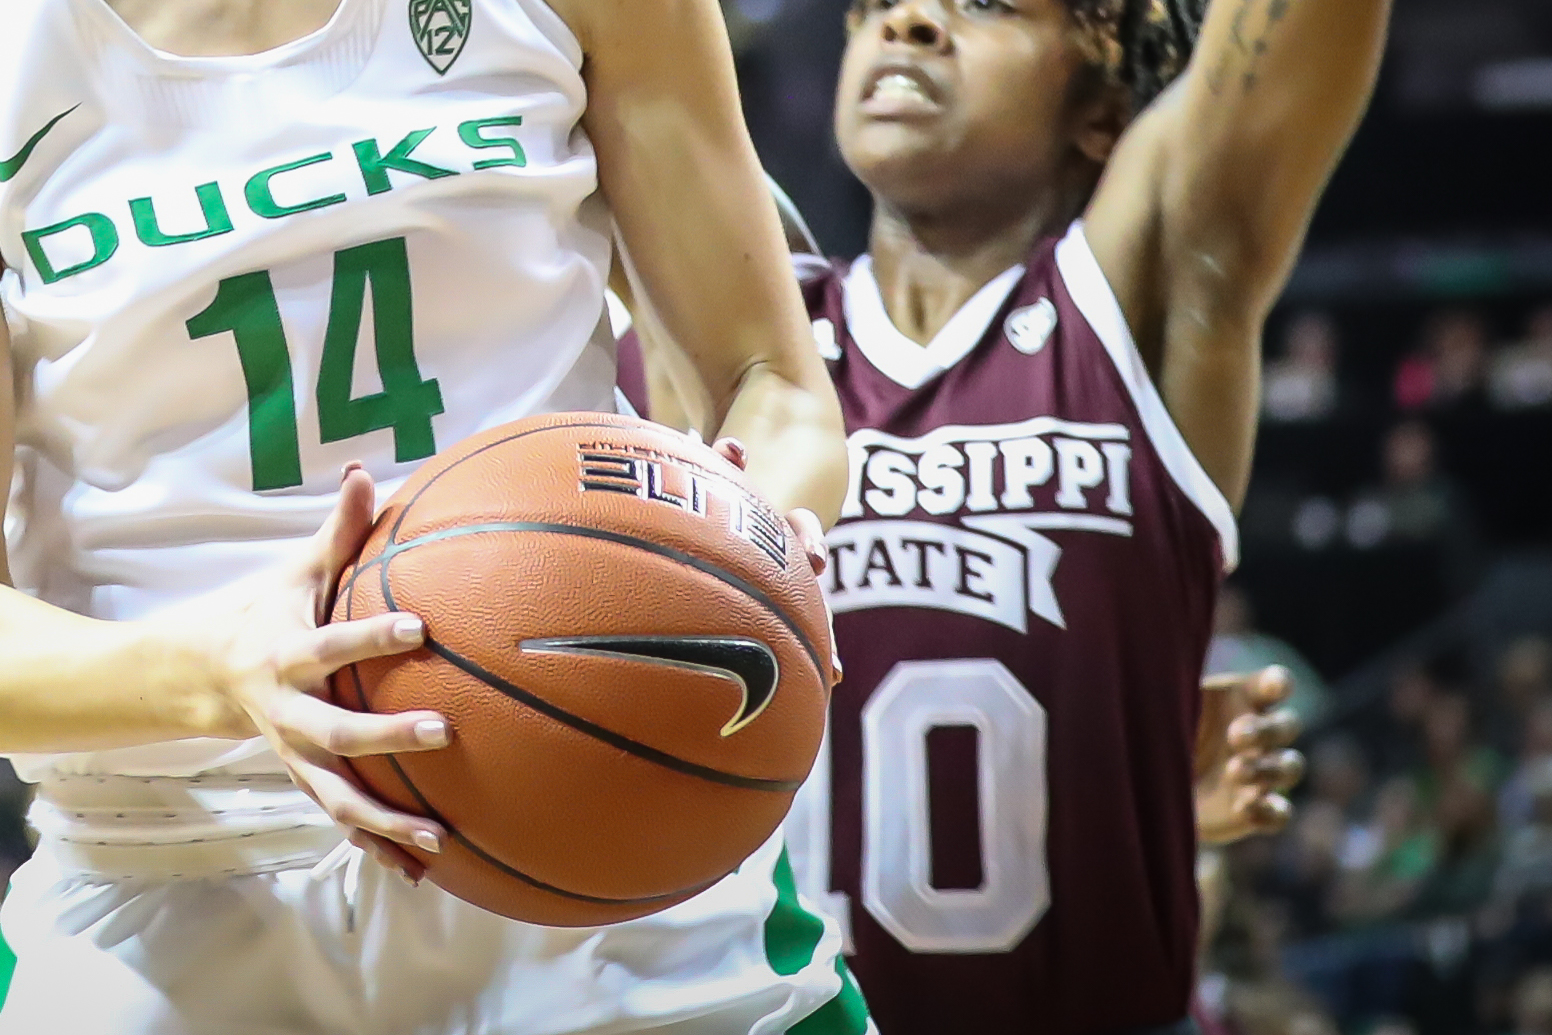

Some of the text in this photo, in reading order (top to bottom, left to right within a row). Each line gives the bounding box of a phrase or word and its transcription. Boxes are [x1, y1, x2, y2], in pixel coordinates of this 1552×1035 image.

[426, 24, 457, 56] 12
[20, 115, 527, 285] DUCKS
[185, 236, 445, 492] 14
[841, 436, 1134, 517] ISSIPPI
[828, 537, 995, 604] TATE
